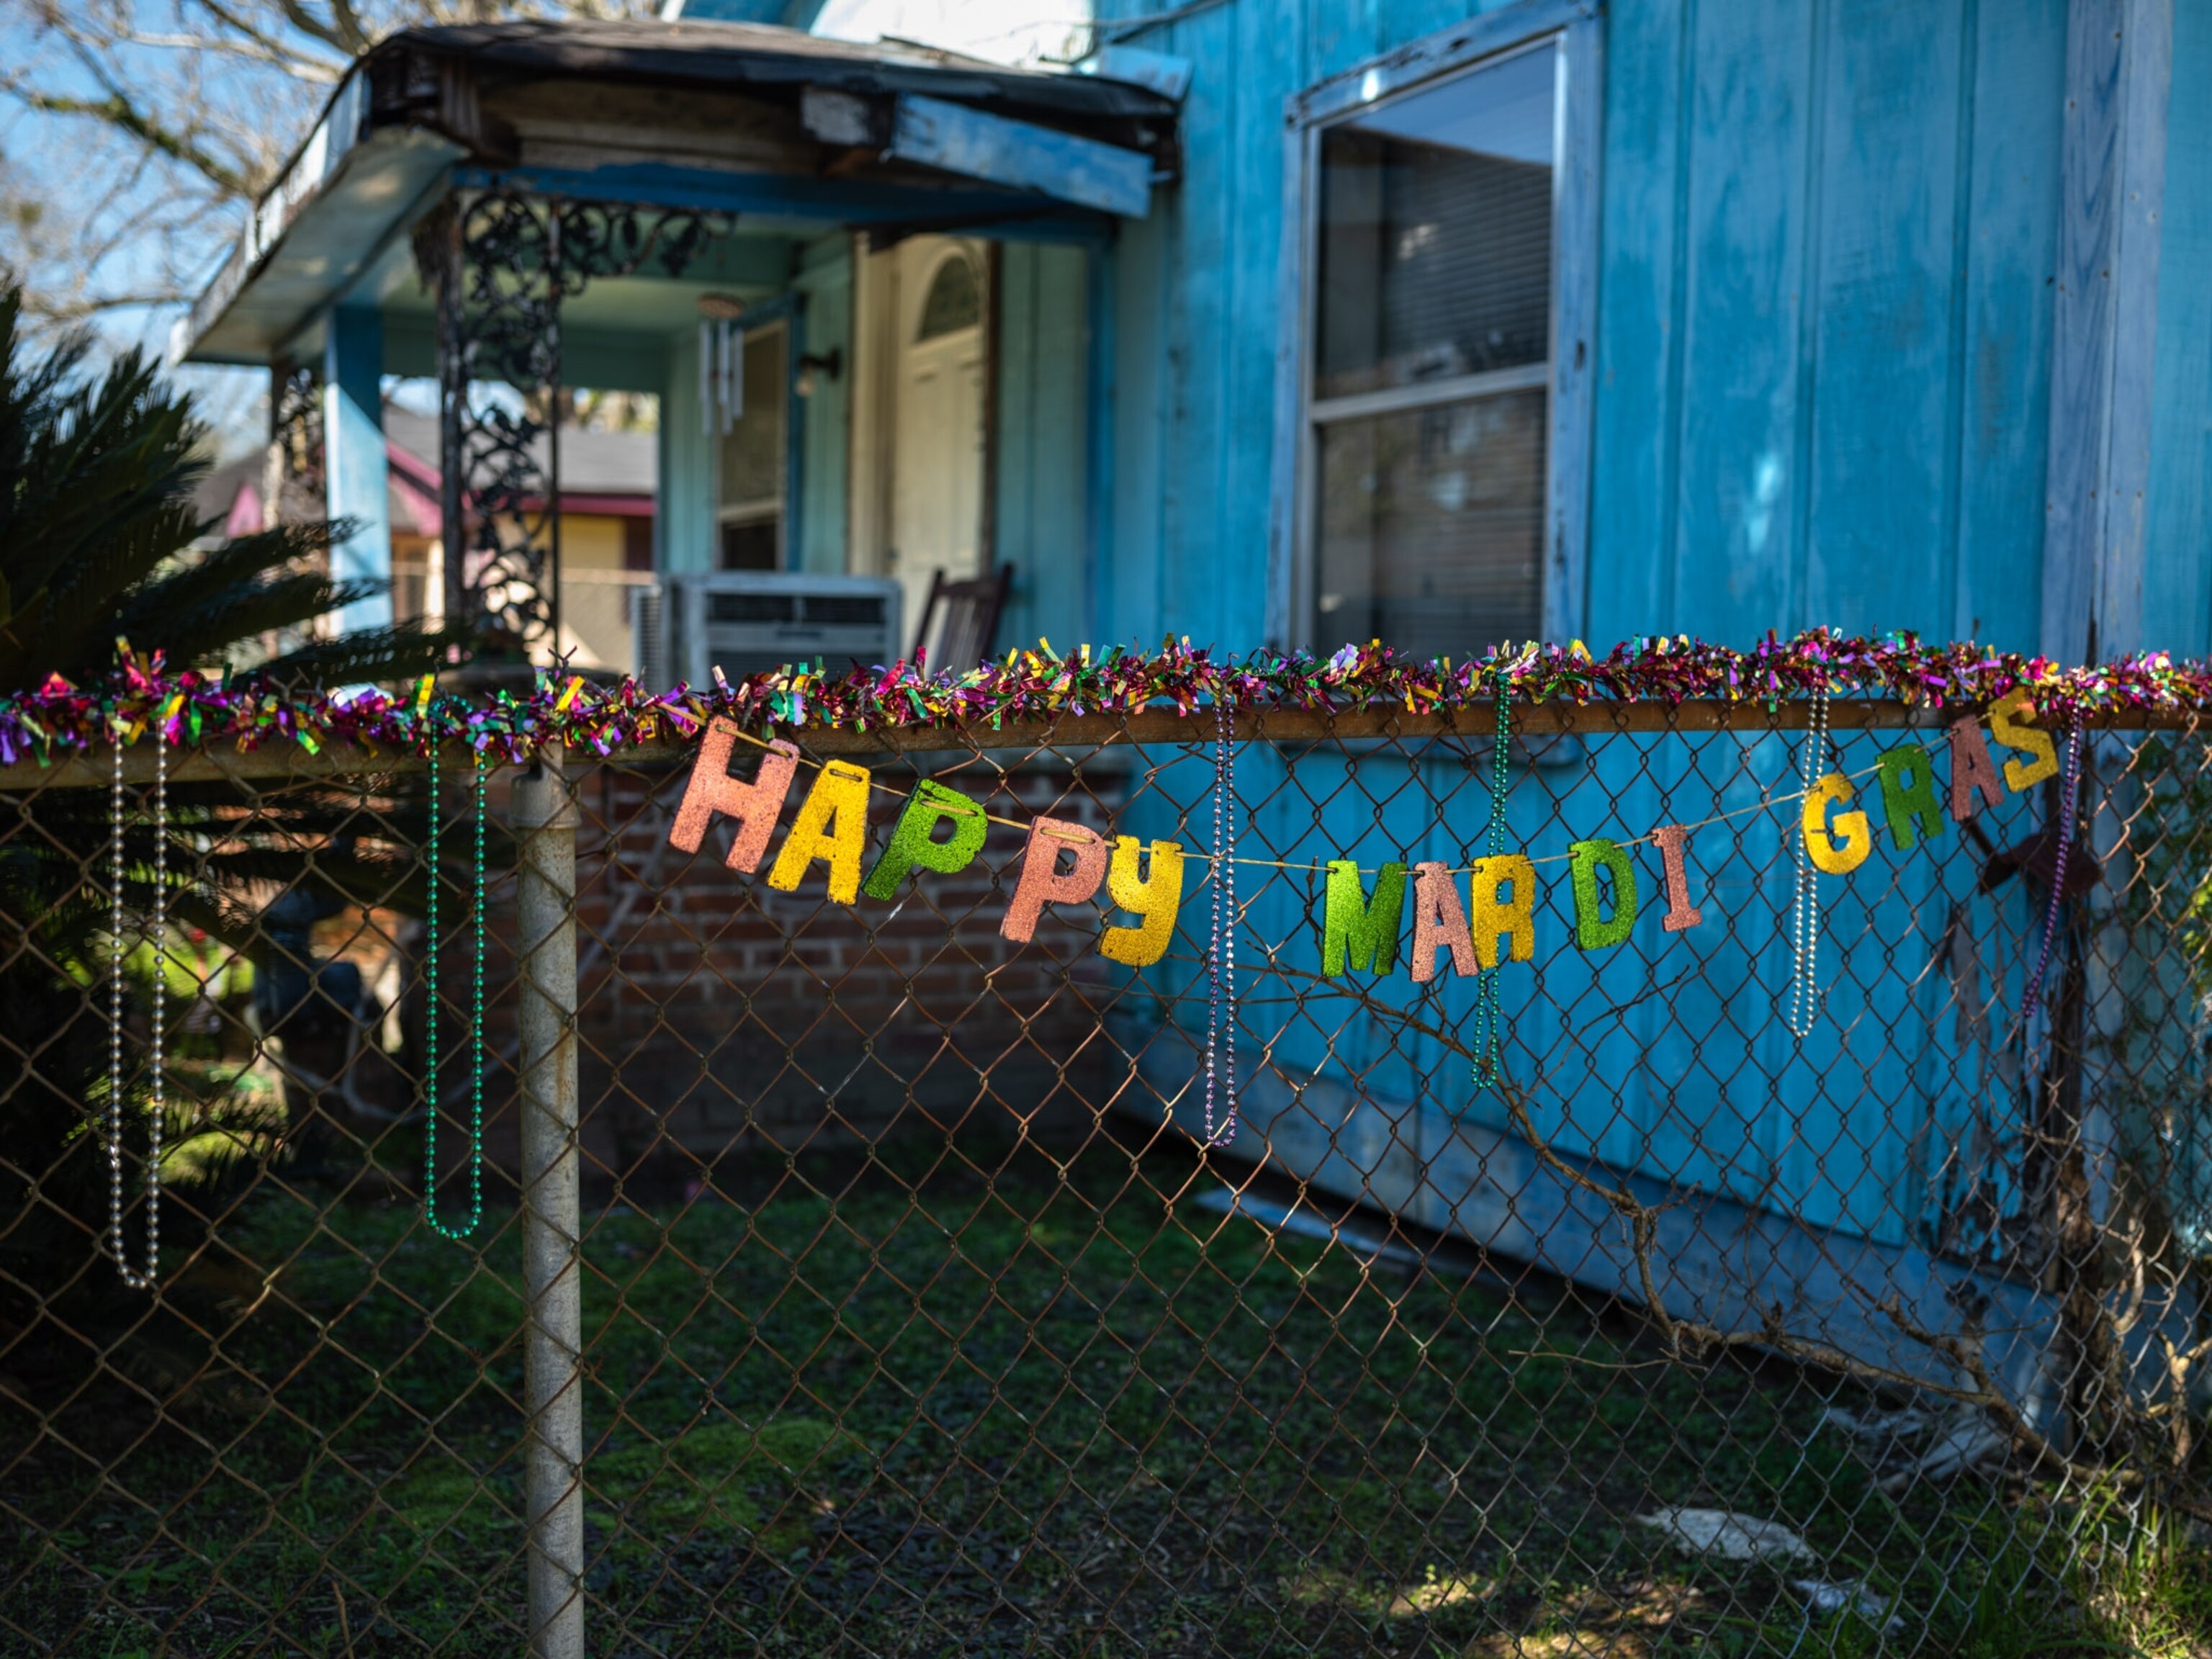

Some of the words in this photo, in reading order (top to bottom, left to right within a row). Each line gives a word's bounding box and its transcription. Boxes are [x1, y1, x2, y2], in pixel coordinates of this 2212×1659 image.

[668, 715, 1184, 966] HAPPY
[1322, 823, 1702, 981] MARDI
[1802, 687, 2059, 874] GRAS
